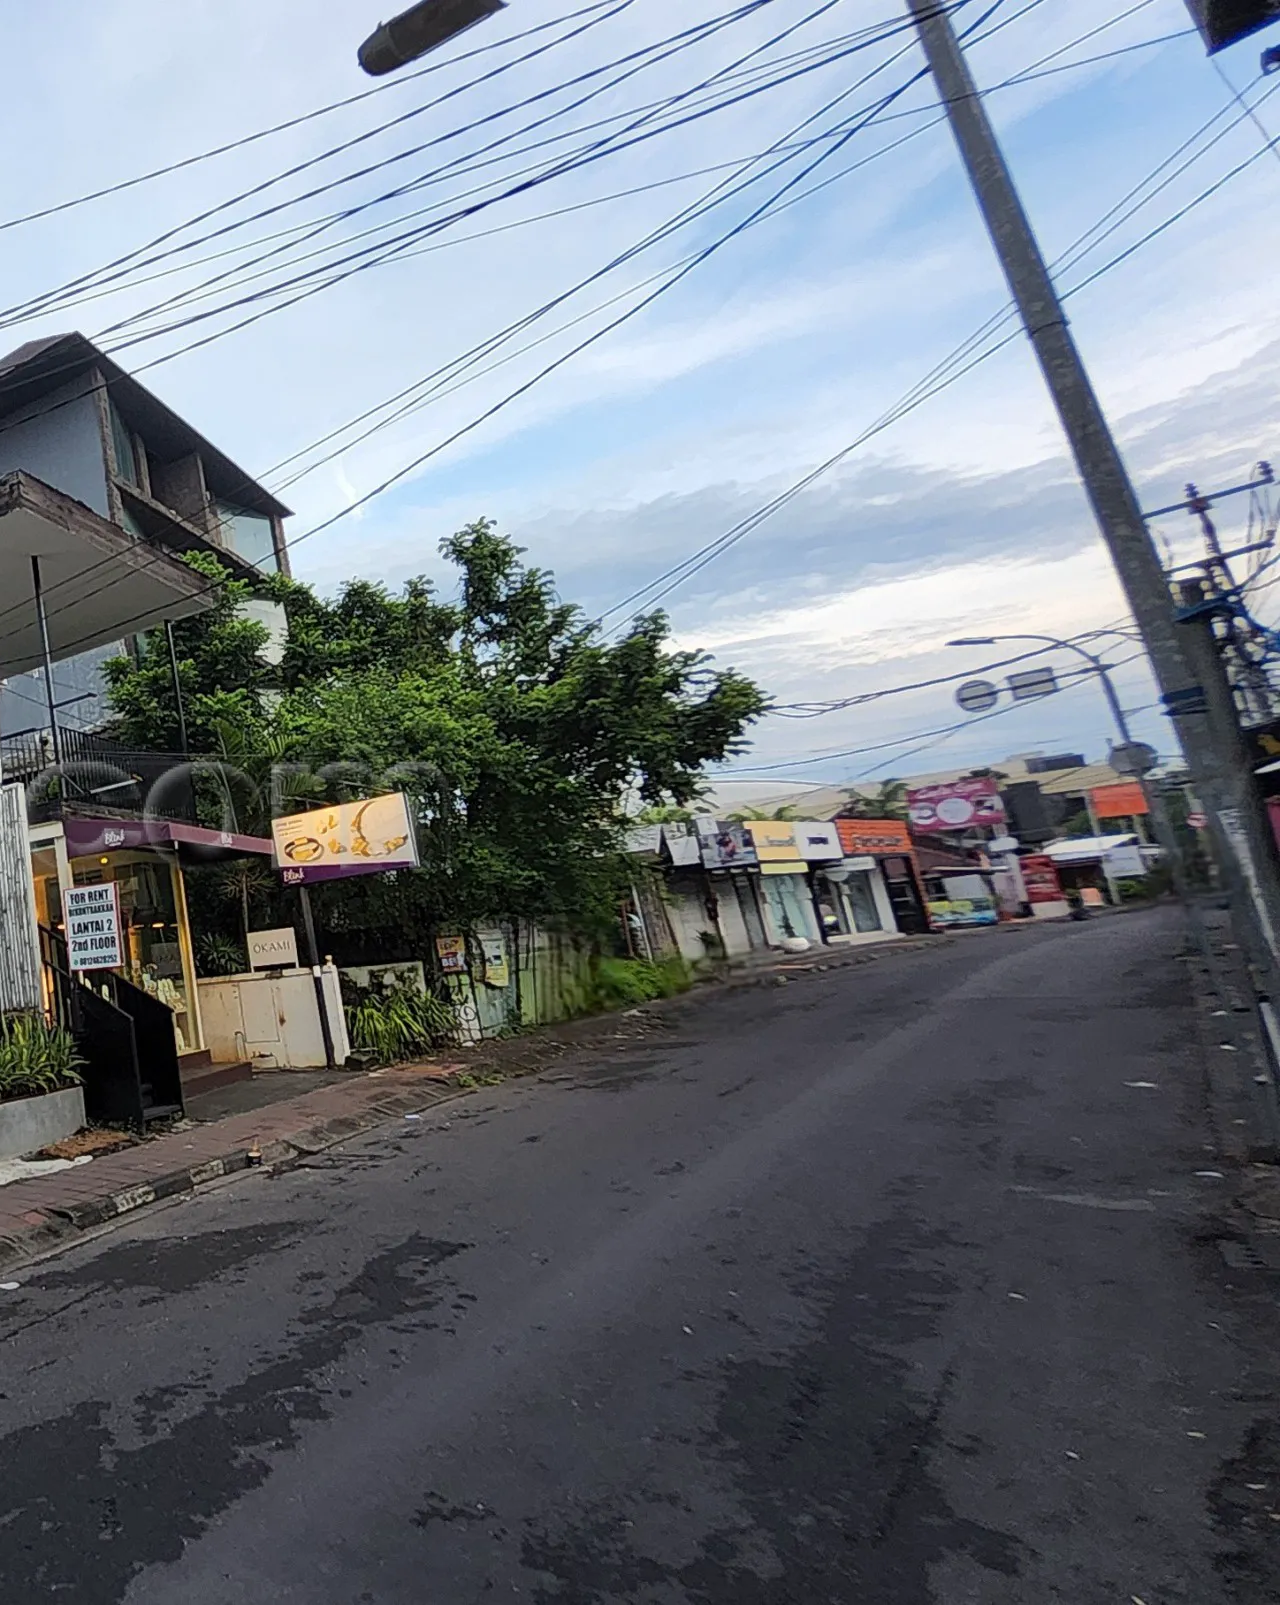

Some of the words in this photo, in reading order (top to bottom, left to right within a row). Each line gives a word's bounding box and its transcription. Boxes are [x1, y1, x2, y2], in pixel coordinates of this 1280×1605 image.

[283, 867, 305, 883] Blink
[70, 893, 86, 905] FOR
[88, 889, 109, 902] RENT
[72, 920, 104, 935] LANTAI
[107, 919, 113, 931] 2
[72, 939, 88, 952] 2nd
[90, 936, 116, 950] FLOOR
[253, 941, 291, 954] OKAMI
